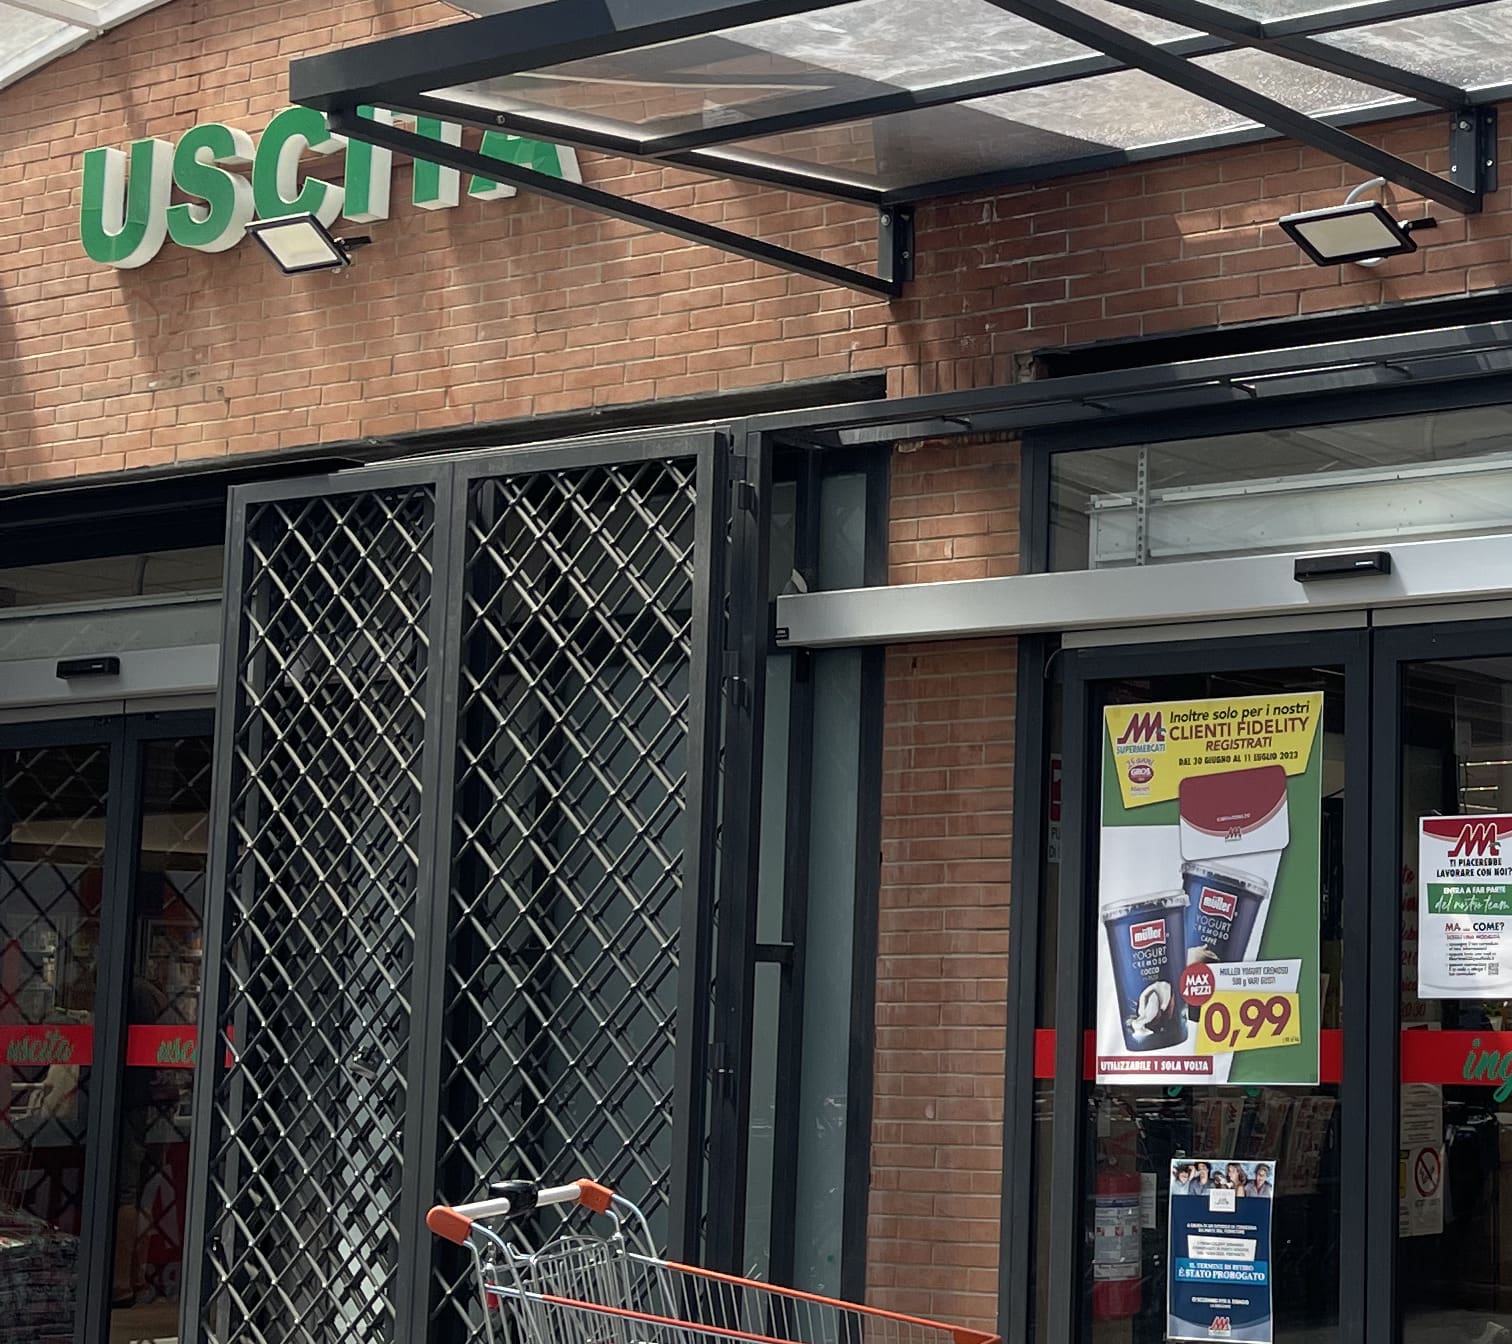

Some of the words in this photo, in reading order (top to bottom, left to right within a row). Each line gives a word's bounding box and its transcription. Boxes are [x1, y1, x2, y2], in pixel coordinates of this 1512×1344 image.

[1169, 709, 1209, 723] Inoltre
[1213, 706, 1238, 720] solo
[1241, 707, 1263, 722] per
[1273, 700, 1310, 716] nostri
[1169, 722, 1232, 741] CLIENTI
[1237, 717, 1310, 736] FIDELITY
[1117, 744, 1166, 754] SUPERMERCATI
[1205, 736, 1273, 752] REGISTRATI
[1178, 758, 1191, 766] DAL
[1204, 755, 1231, 765] GIUGNO
[1233, 755, 1241, 763] AL
[1253, 752, 1277, 762] LUGLIO
[1449, 859, 1456, 867] TI
[1458, 858, 1502, 866] PIACEREBBE
[1436, 868, 1475, 878] LAVORARE
[1477, 868, 1492, 877] CON
[1494, 867, 1512, 876] NOI?
[1196, 915, 1232, 933] YOGURT
[1445, 922, 1461, 931] MA
[1472, 921, 1505, 931] COME?
[1193, 923, 1230, 941] CREMOSO
[1132, 946, 1167, 961] YOGURT
[1132, 956, 1168, 969] CREMOSO
[1185, 974, 1209, 986] MAX
[1204, 995, 1291, 1047] 0,99
[6, 1029, 74, 1063] uscita
[1100, 1060, 1151, 1071] UTILIZZABILE
[1161, 1060, 1182, 1071] SOLA
[1184, 1060, 1209, 1071] VOLTA
[1185, 1269, 1212, 1278] STATO
